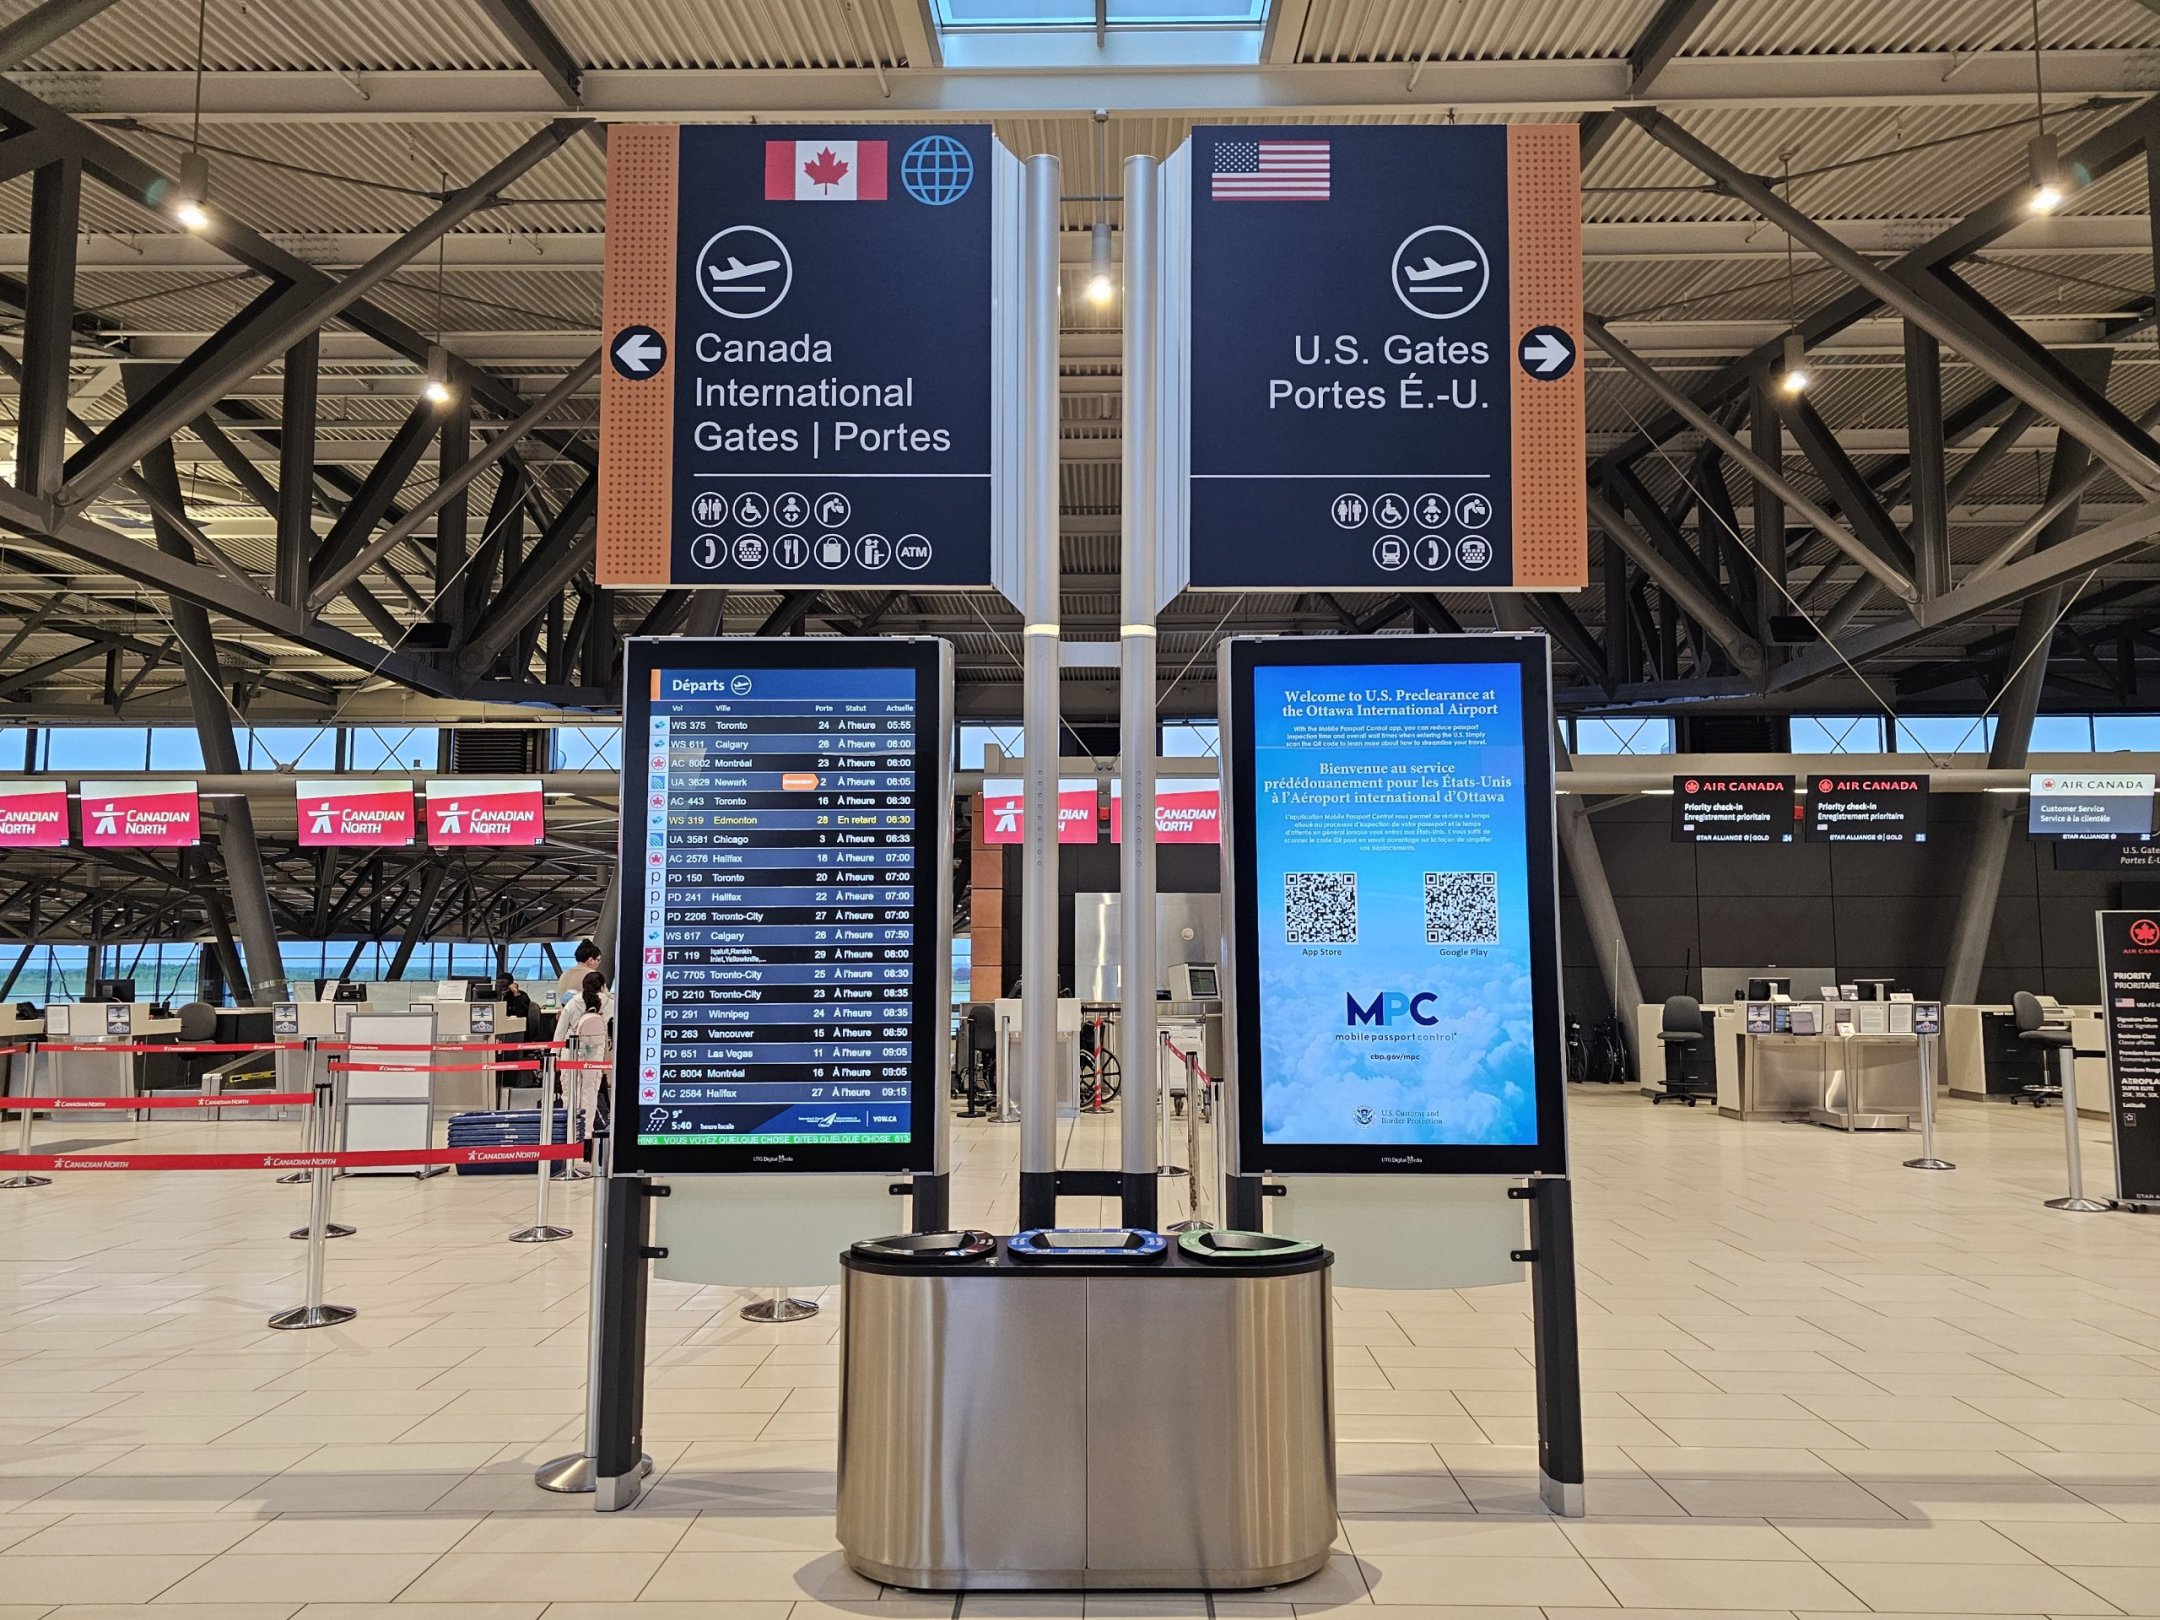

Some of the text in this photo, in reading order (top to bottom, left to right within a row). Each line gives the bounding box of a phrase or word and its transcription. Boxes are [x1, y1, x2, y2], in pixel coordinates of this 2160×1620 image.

[696, 333, 833, 363] Canada
[1295, 335, 1489, 365] U.S. Gates
[696, 377, 913, 407] International
[1270, 373, 1489, 409] Portes É.-U.
[694, 422, 950, 453] Gates Portes
[900, 546, 928, 557] ATM
[672, 679, 725, 694] Départs
[1285, 689, 1495, 702] Welcome to U.S. Preclearance at
[1282, 703, 1498, 717] the Ottawa International Airport
[671, 722, 687, 730] WS
[689, 722, 706, 730] 375
[716, 722, 748, 730] Toronto
[887, 721, 911, 729] 05:55
[1320, 763, 1455, 775] Bienvenue au service
[1264, 774, 1511, 792] prédédouanement pour les États-Unis
[1704, 782, 1784, 791] AIR CANADA
[1837, 781, 1918, 790] AIR CANADA
[1272, 793, 1279, 803] à
[1354, 791, 1441, 803] international
[1684, 803, 1743, 812] Priority check-in
[1818, 803, 1845, 812] Priority
[127, 810, 190, 822] CANADIAN
[342, 809, 405, 821] CANADIAN
[471, 809, 534, 821] CANADIAN
[669, 816, 685, 824] WS
[688, 816, 704, 824] 319
[714, 816, 757, 824] Edmonton
[838, 816, 849, 824] En
[851, 816, 877, 824] retard
[1059, 810, 1088, 819] DIAN
[1684, 813, 1770, 822] Enregistrement prioritaire
[1818, 812, 1904, 822] Enregistrement prioritaire
[125, 823, 166, 834] NORTH
[341, 822, 381, 834] NORTH
[470, 822, 510, 834] NORTH
[668, 874, 682, 882] PD
[687, 874, 702, 882] 150
[712, 874, 744, 882] Toronto
[816, 873, 828, 881] 20
[886, 873, 910, 881] 07:00
[1302, 949, 1318, 957] App
[1440, 949, 1488, 957] Google Play
[666, 971, 679, 979] AC
[683, 971, 705, 979] 7705
[710, 970, 762, 981] Toronto-City
[814, 970, 825, 978] 25
[884, 970, 908, 978] 08:30
[1346, 992, 1439, 1026] MPC
[664, 1011, 678, 1019] PD
[682, 1011, 698, 1019] 291
[709, 1010, 749, 1021] Winnipeg
[813, 1009, 825, 1017] 24
[883, 1009, 908, 1017] 08:35
[664, 1030, 677, 1039] PD
[681, 1030, 698, 1039] 263
[708, 1030, 754, 1038] Vancouver
[814, 1029, 824, 1037] 15
[883, 1029, 907, 1037] 08:50
[1372, 1033, 1415, 1042] passport
[662, 1070, 676, 1078] AC
[680, 1070, 702, 1078] 8004
[707, 1069, 745, 1078] Montréal
[813, 1069, 824, 1077] 16
[883, 1069, 907, 1077] 09:05
[672, 1122, 692, 1130] 5:40
[718, 1136, 758, 1144] QUELQUE
